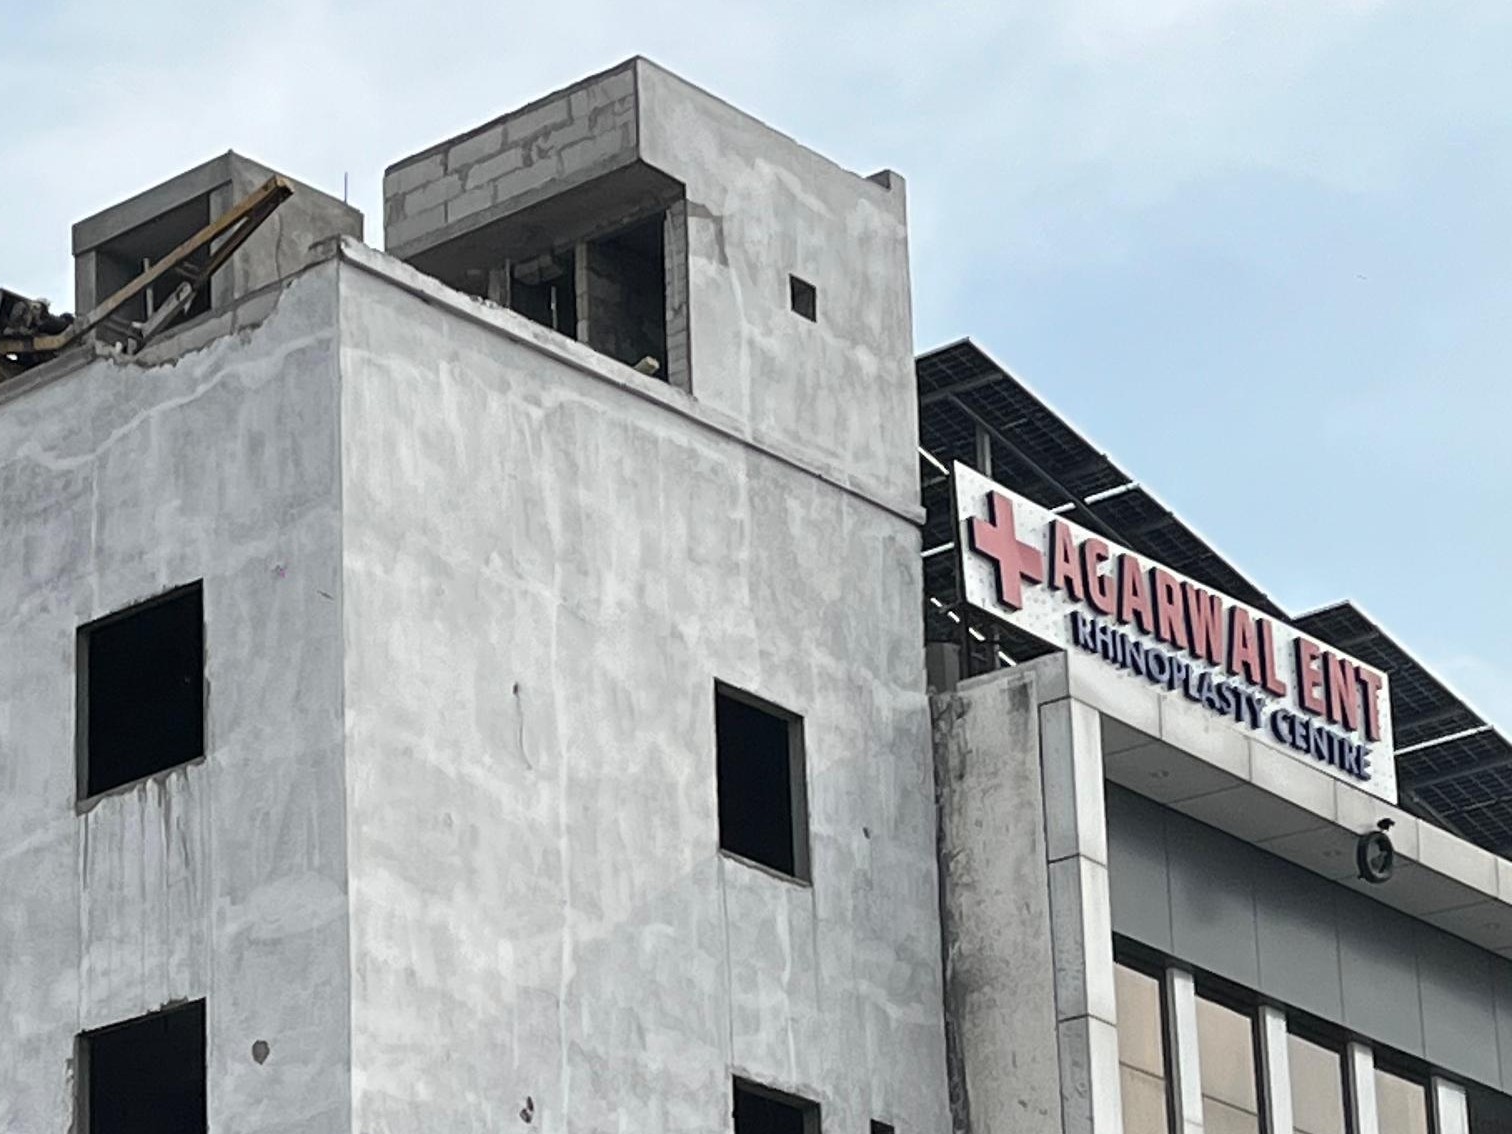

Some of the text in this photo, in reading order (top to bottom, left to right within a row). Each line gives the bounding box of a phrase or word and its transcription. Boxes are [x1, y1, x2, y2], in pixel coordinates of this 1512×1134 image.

[1050, 519, 1383, 742] AGARWAL ENT
[1070, 611, 1371, 781] RHINOPLASTY CENTRE
